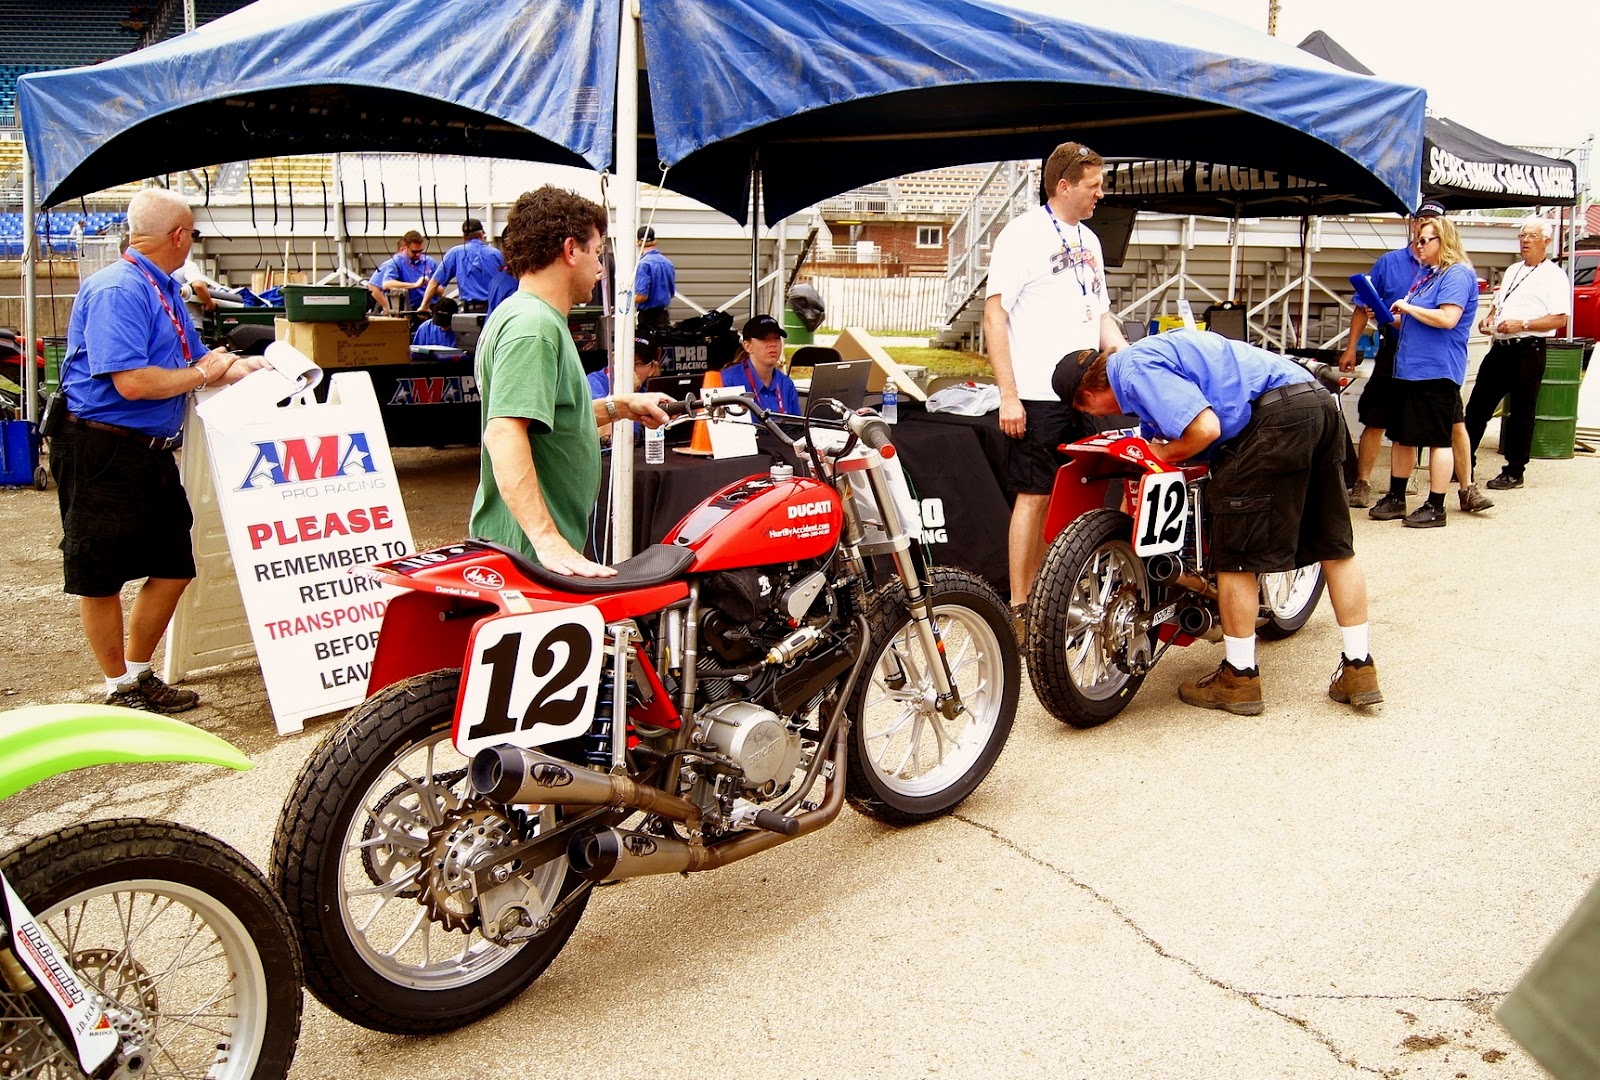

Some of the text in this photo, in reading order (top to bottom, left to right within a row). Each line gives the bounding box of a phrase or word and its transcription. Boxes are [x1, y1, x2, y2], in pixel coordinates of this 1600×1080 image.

[1102, 159, 1280, 195] EAMIN' EAGLE
[674, 346, 707, 362] PRO
[675, 362, 708, 370] RACING
[387, 376, 463, 405] AMA
[233, 431, 383, 492] AMA
[282, 478, 386, 500] PRO RACING
[787, 500, 832, 519] DUCATI
[1140, 481, 1185, 546] 12
[247, 505, 393, 550] PLEASE
[254, 545, 379, 582] REMEMBER
[382, 541, 407, 559] TO
[299, 575, 383, 603] RETURN
[264, 599, 391, 640] TRANSPOND
[320, 661, 375, 690] LEAV
[468, 623, 592, 740] 12
[21, 921, 86, 1004] McCormick
[48, 975, 72, 1006] HEATING
